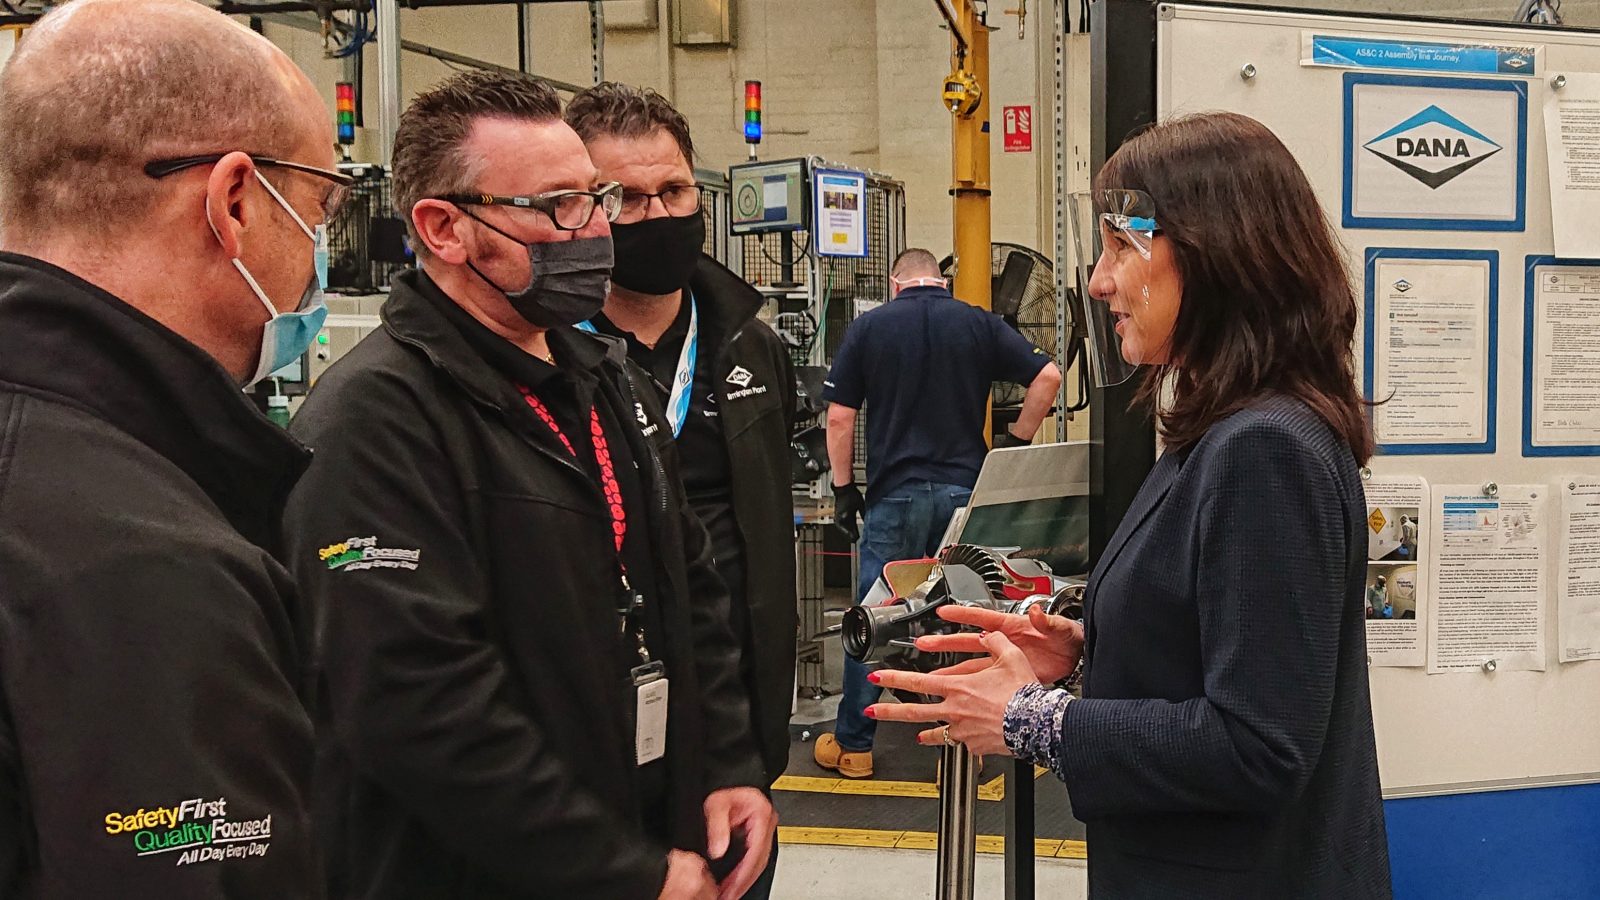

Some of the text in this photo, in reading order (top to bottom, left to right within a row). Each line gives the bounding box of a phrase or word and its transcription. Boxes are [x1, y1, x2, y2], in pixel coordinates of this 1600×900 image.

[1355, 48, 1377, 58] AS&C
[1378, 49, 1384, 58] 2
[1384, 49, 1418, 61] Assembly
[1396, 137, 1471, 158] DANA
[176, 842, 270, 866] All Day Every Day
